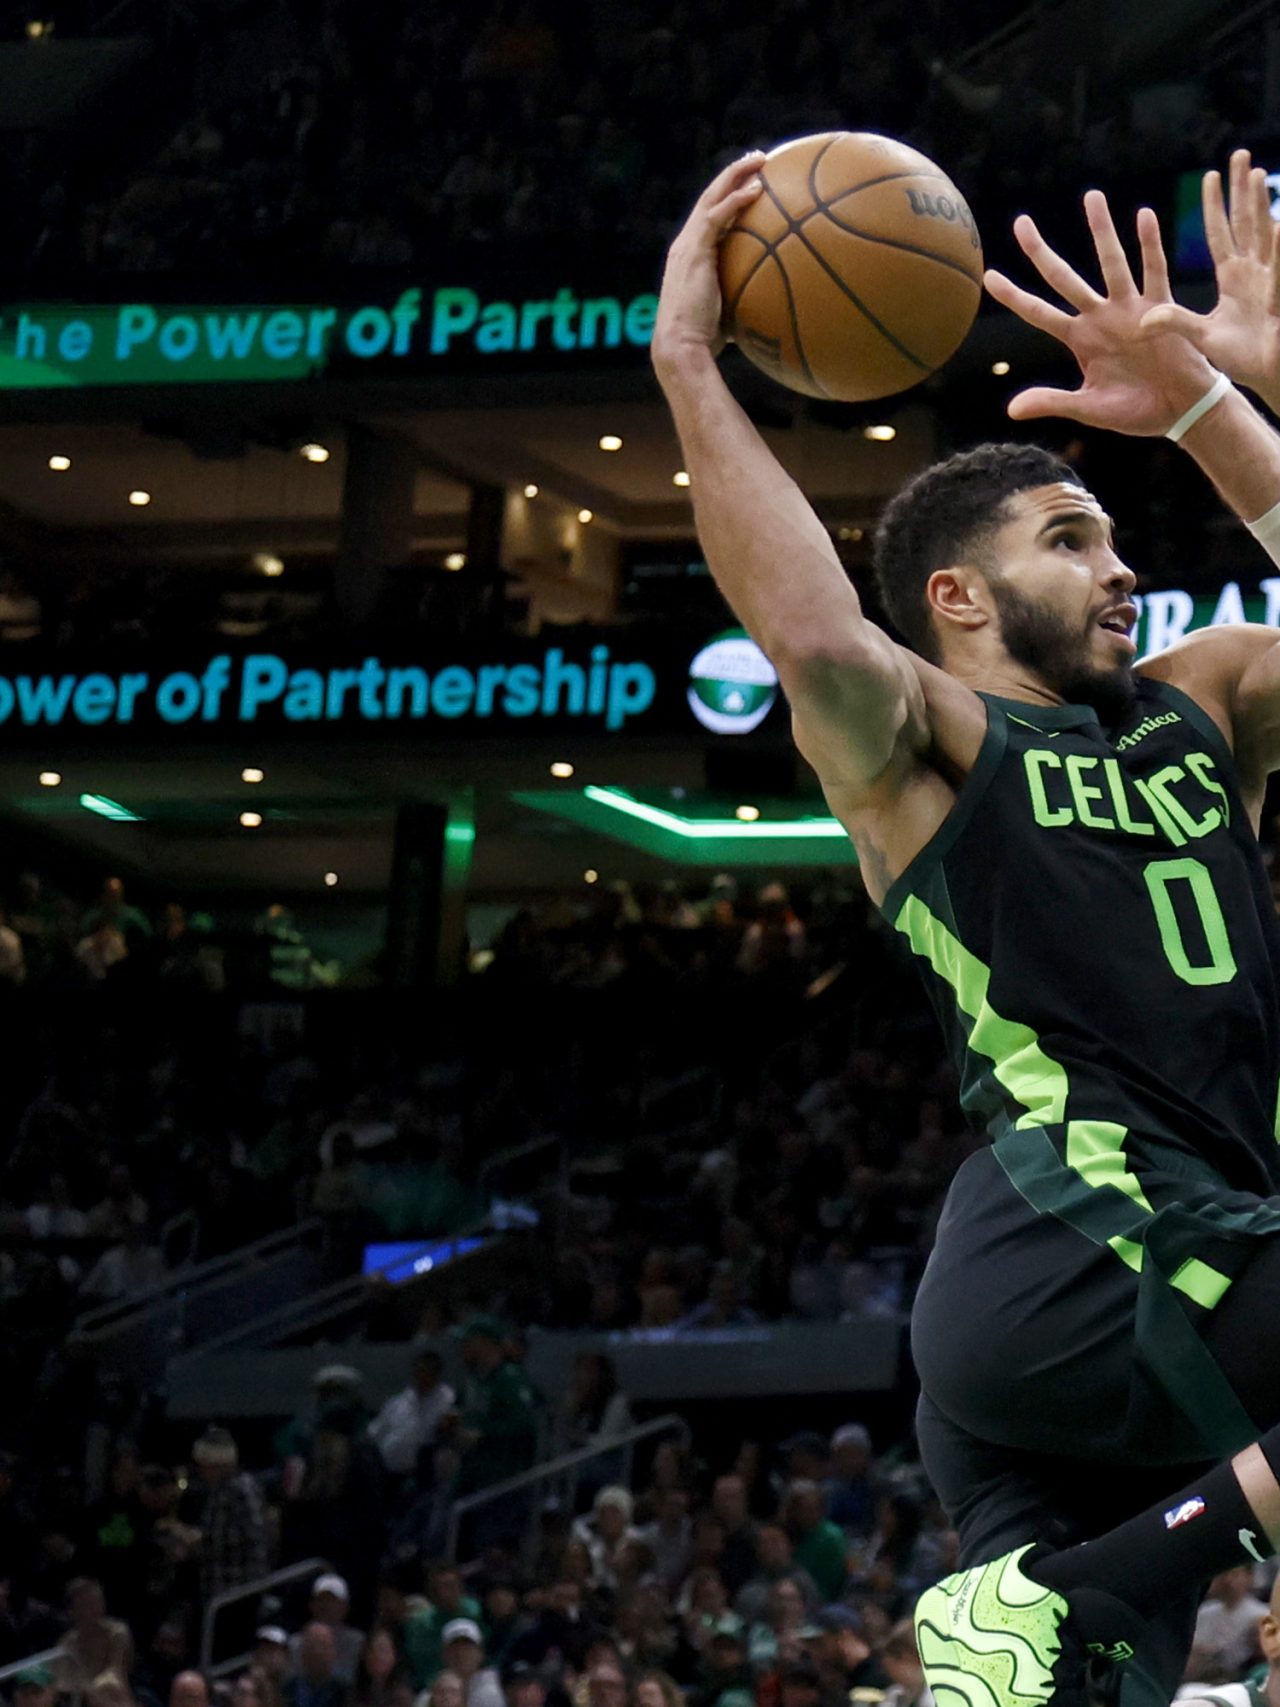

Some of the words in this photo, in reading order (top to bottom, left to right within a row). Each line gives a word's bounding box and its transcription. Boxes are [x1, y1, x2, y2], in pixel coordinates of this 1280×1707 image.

[0, 312, 94, 362] he
[115, 304, 336, 362] Power
[345, 287, 425, 359] of
[430, 287, 660, 357] Partne
[155, 653, 232, 724] of
[237, 642, 658, 732] Partnership
[1115, 710, 1182, 751] Amica
[1142, 857, 1238, 986] 0
